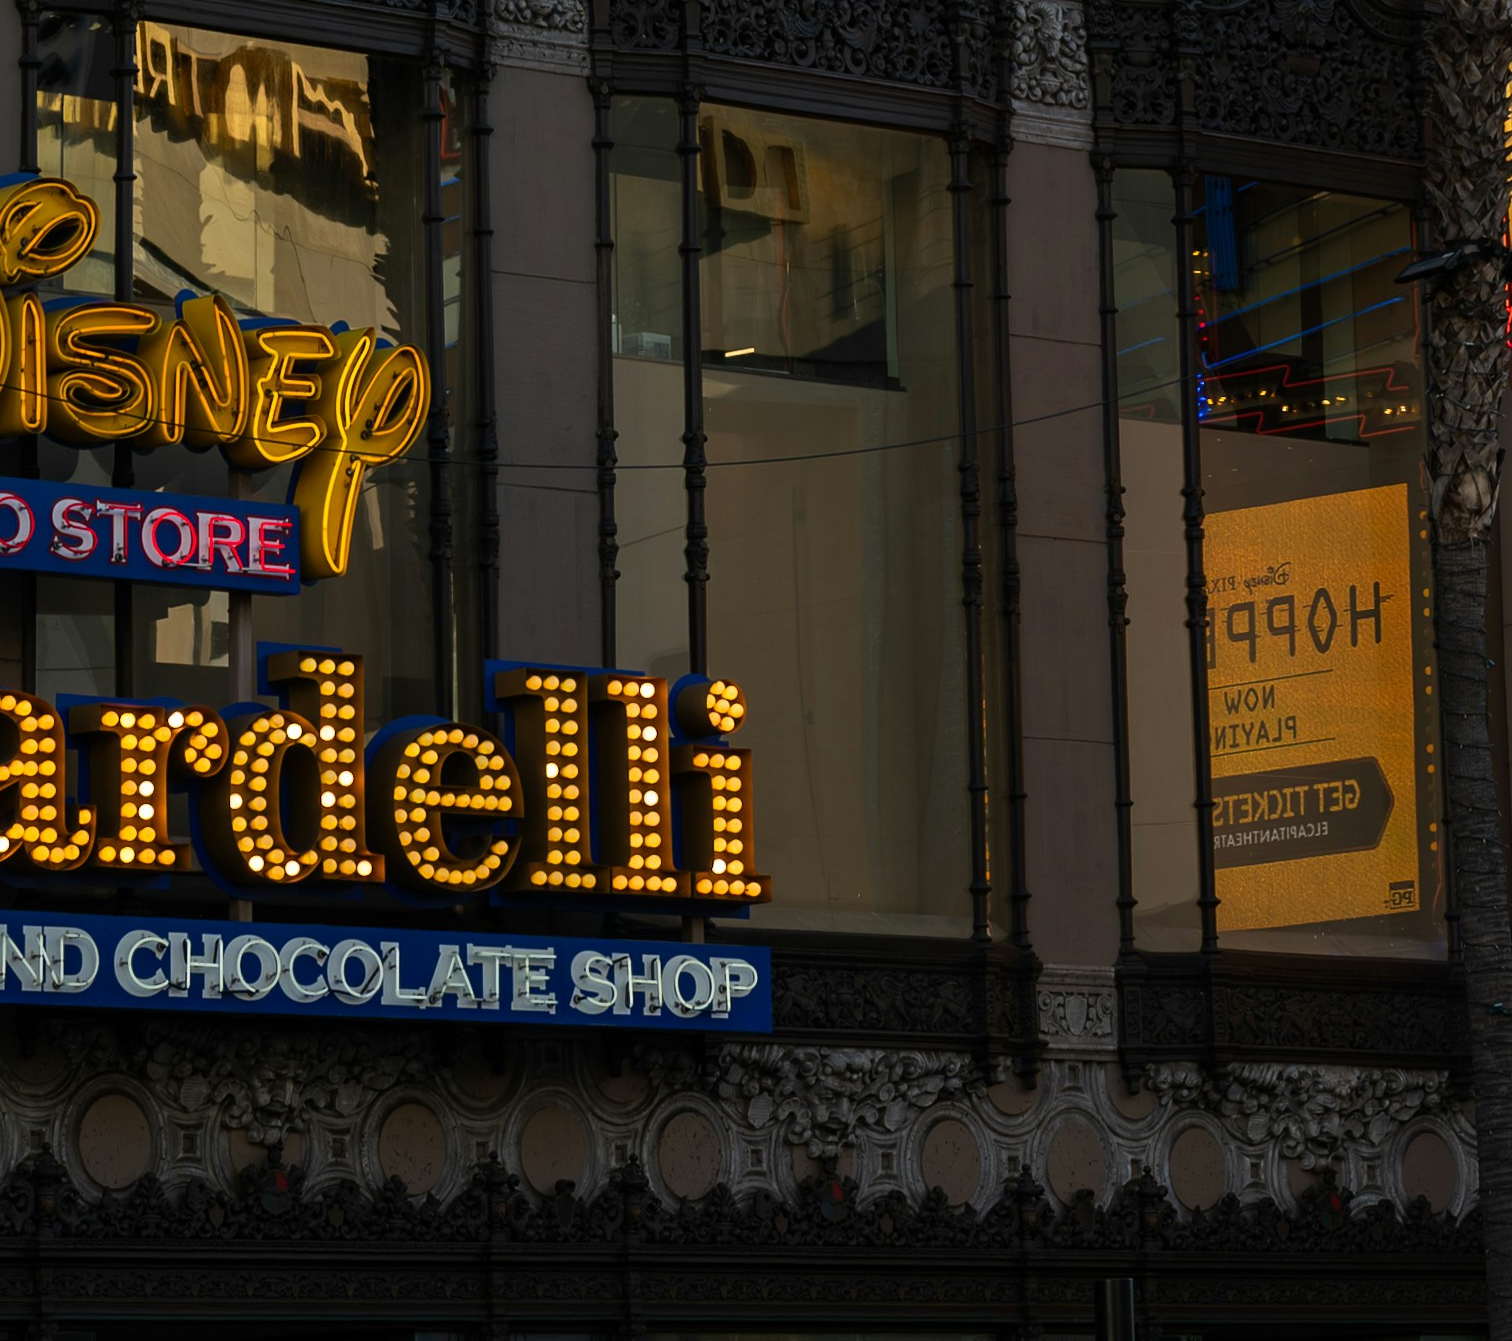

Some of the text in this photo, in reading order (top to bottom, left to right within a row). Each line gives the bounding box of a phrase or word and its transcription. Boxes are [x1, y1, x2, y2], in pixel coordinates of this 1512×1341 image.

[49, 496, 296, 581] STORE
[113, 928, 557, 1015] CHOCOLATE
[569, 948, 759, 1020] SHOP
